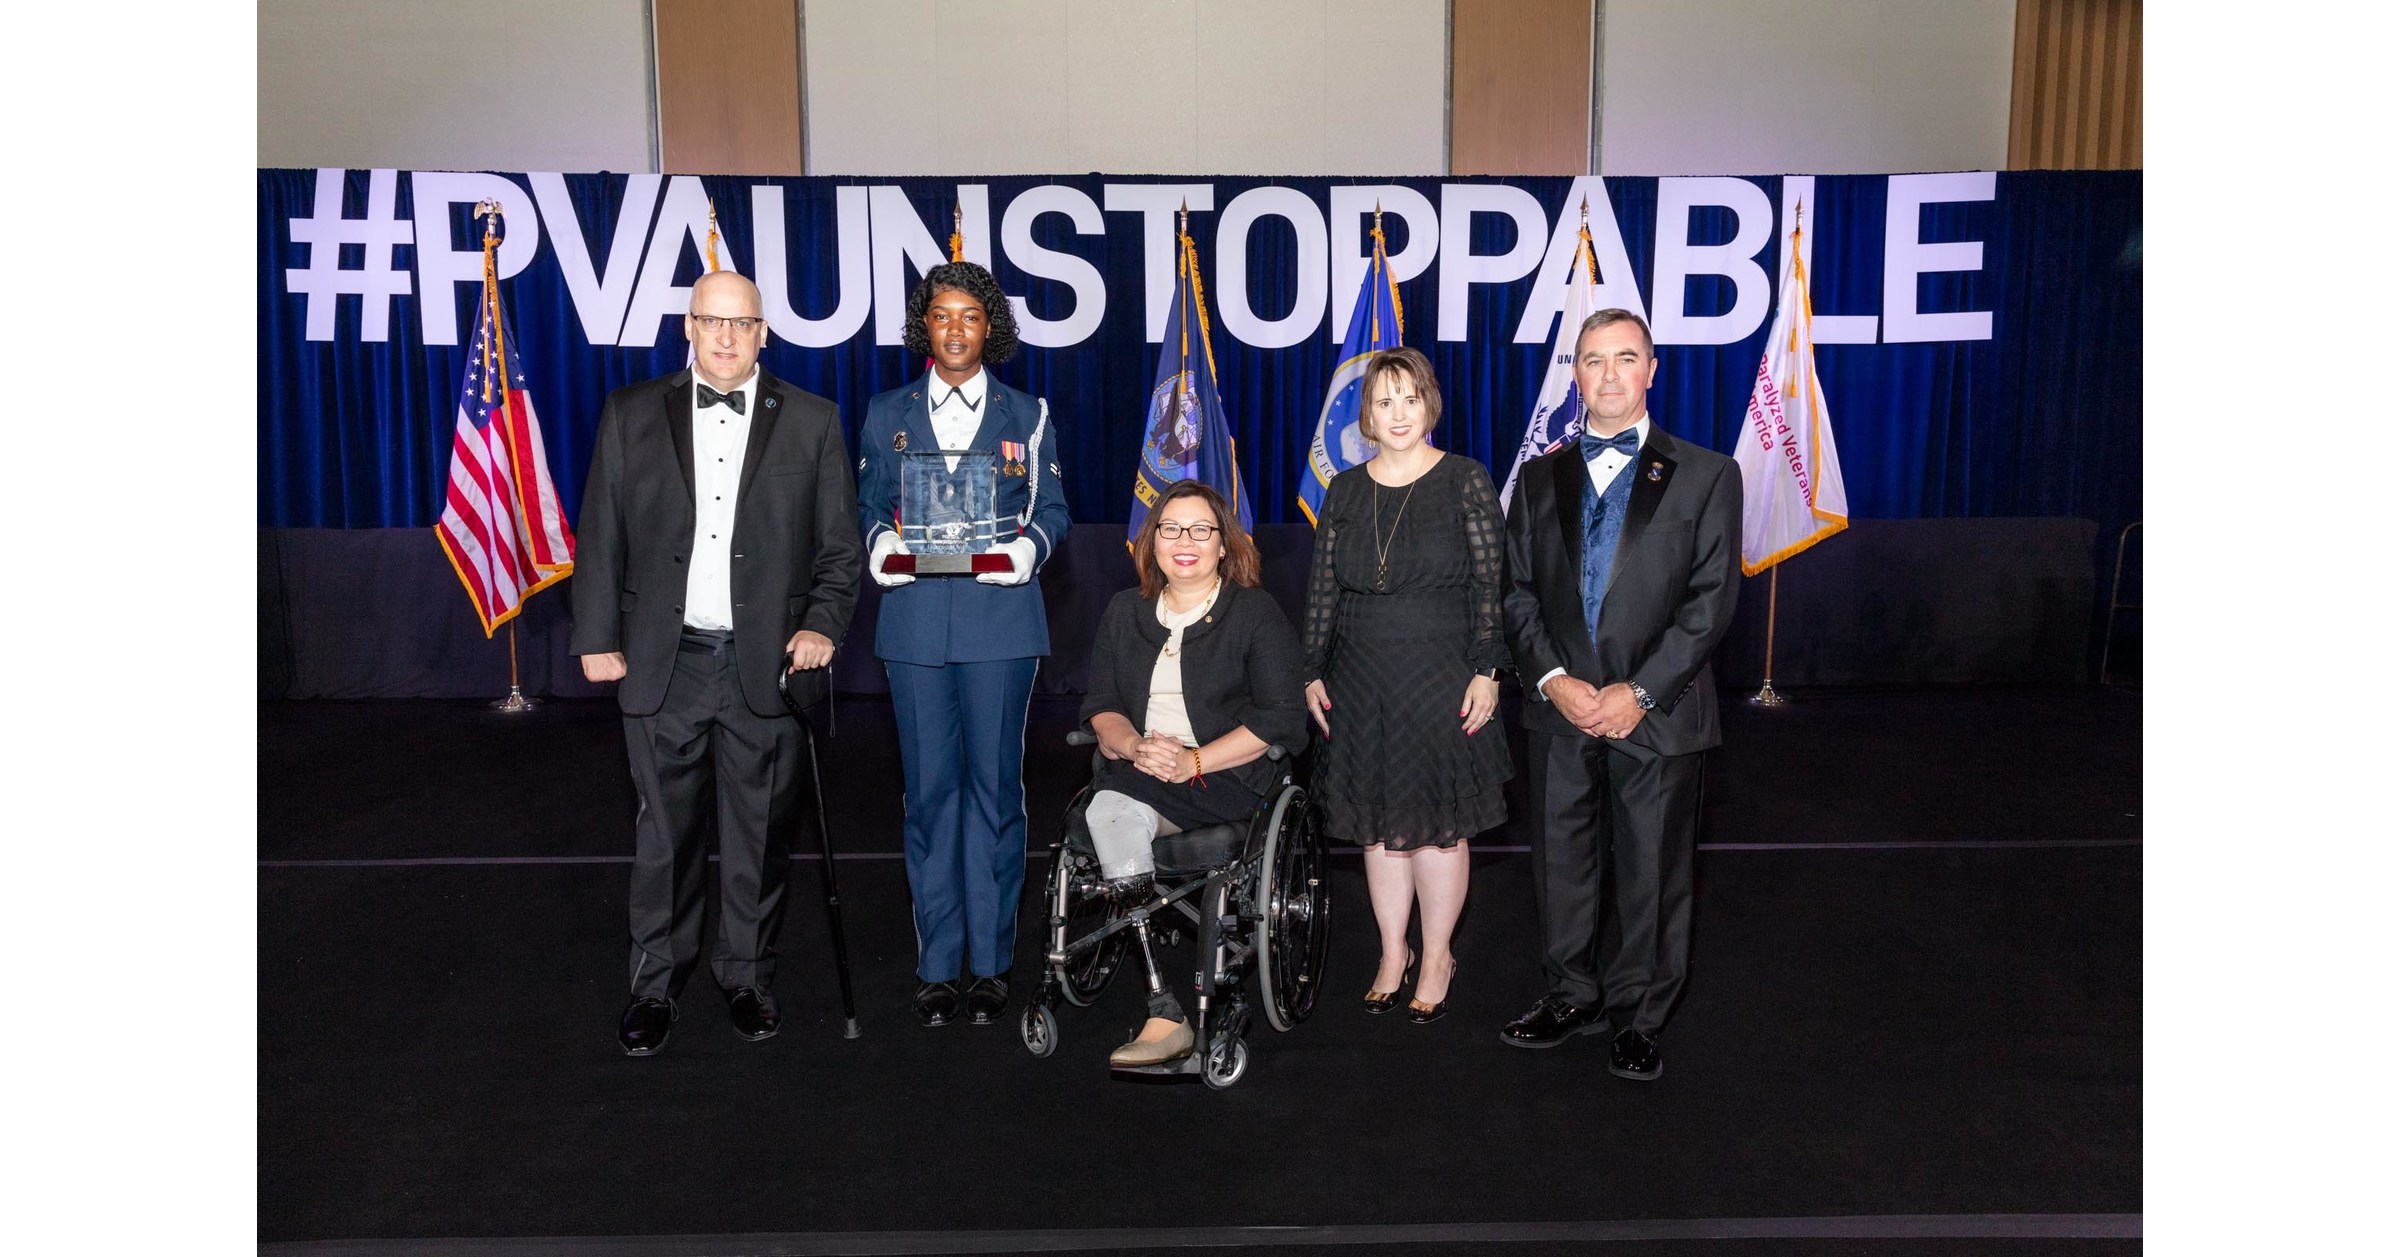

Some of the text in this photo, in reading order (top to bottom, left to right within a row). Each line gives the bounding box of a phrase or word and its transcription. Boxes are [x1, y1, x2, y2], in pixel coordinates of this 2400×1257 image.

[286, 168, 1996, 348] #PVAUNSTOPPABLE
[1312, 434, 1324, 459] AIR
[1747, 386, 1774, 451] merica
[1135, 476, 1148, 495] ES
[1781, 434, 1812, 508] Veterans
